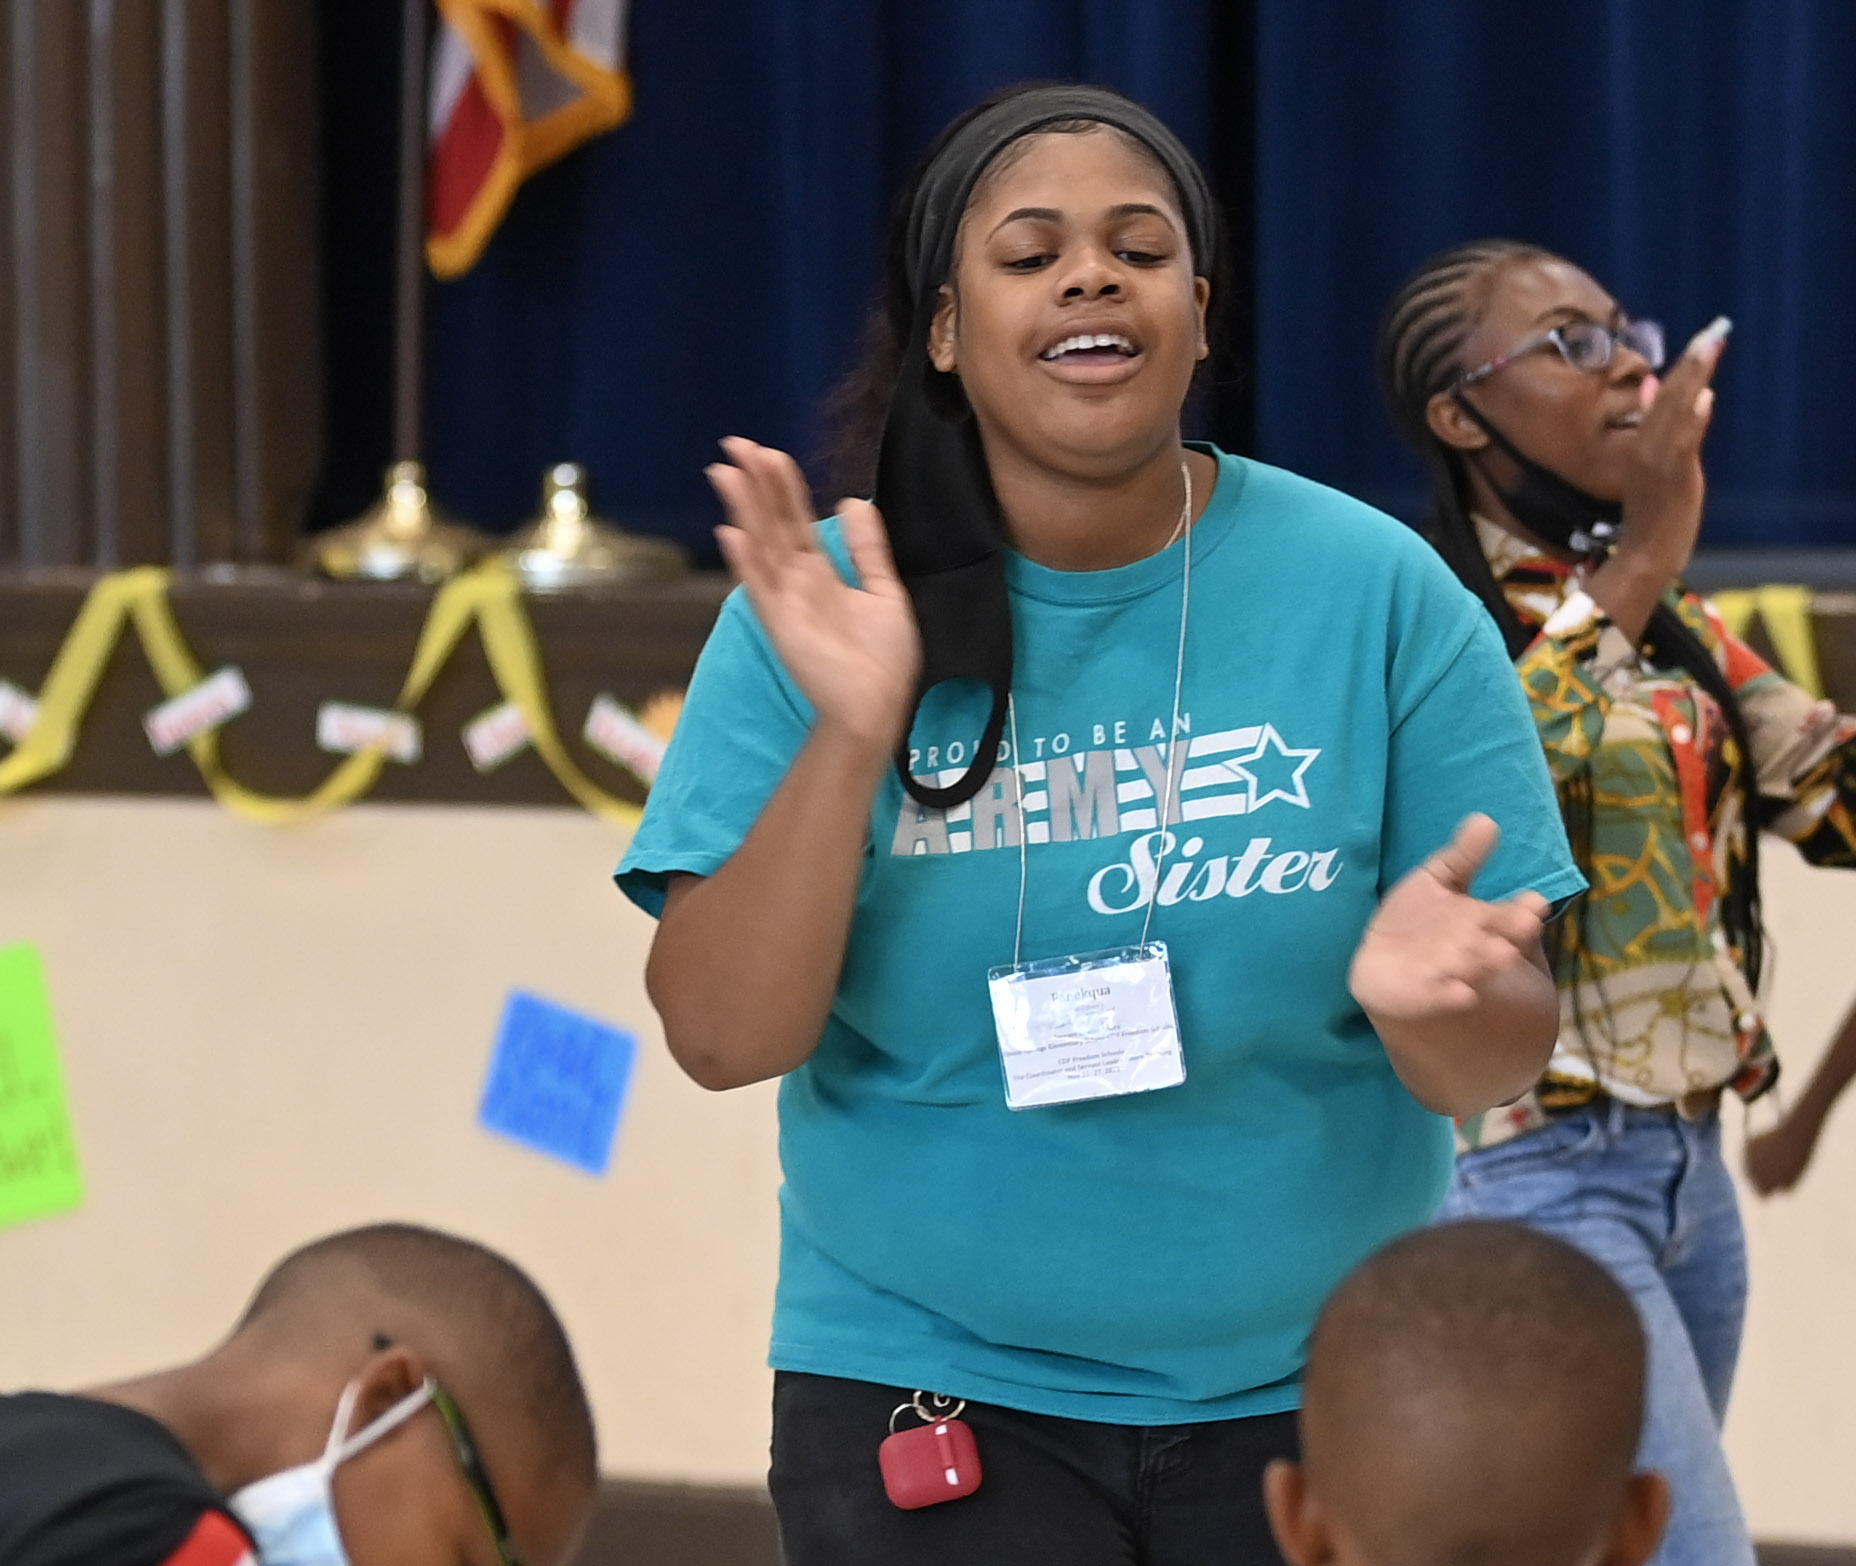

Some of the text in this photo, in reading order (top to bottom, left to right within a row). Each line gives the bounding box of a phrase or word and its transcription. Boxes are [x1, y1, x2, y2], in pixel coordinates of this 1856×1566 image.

[908, 713, 1191, 770] PROD TO BE AN
[891, 738, 1192, 856] ARMY
[1087, 830, 1343, 915] Sister
